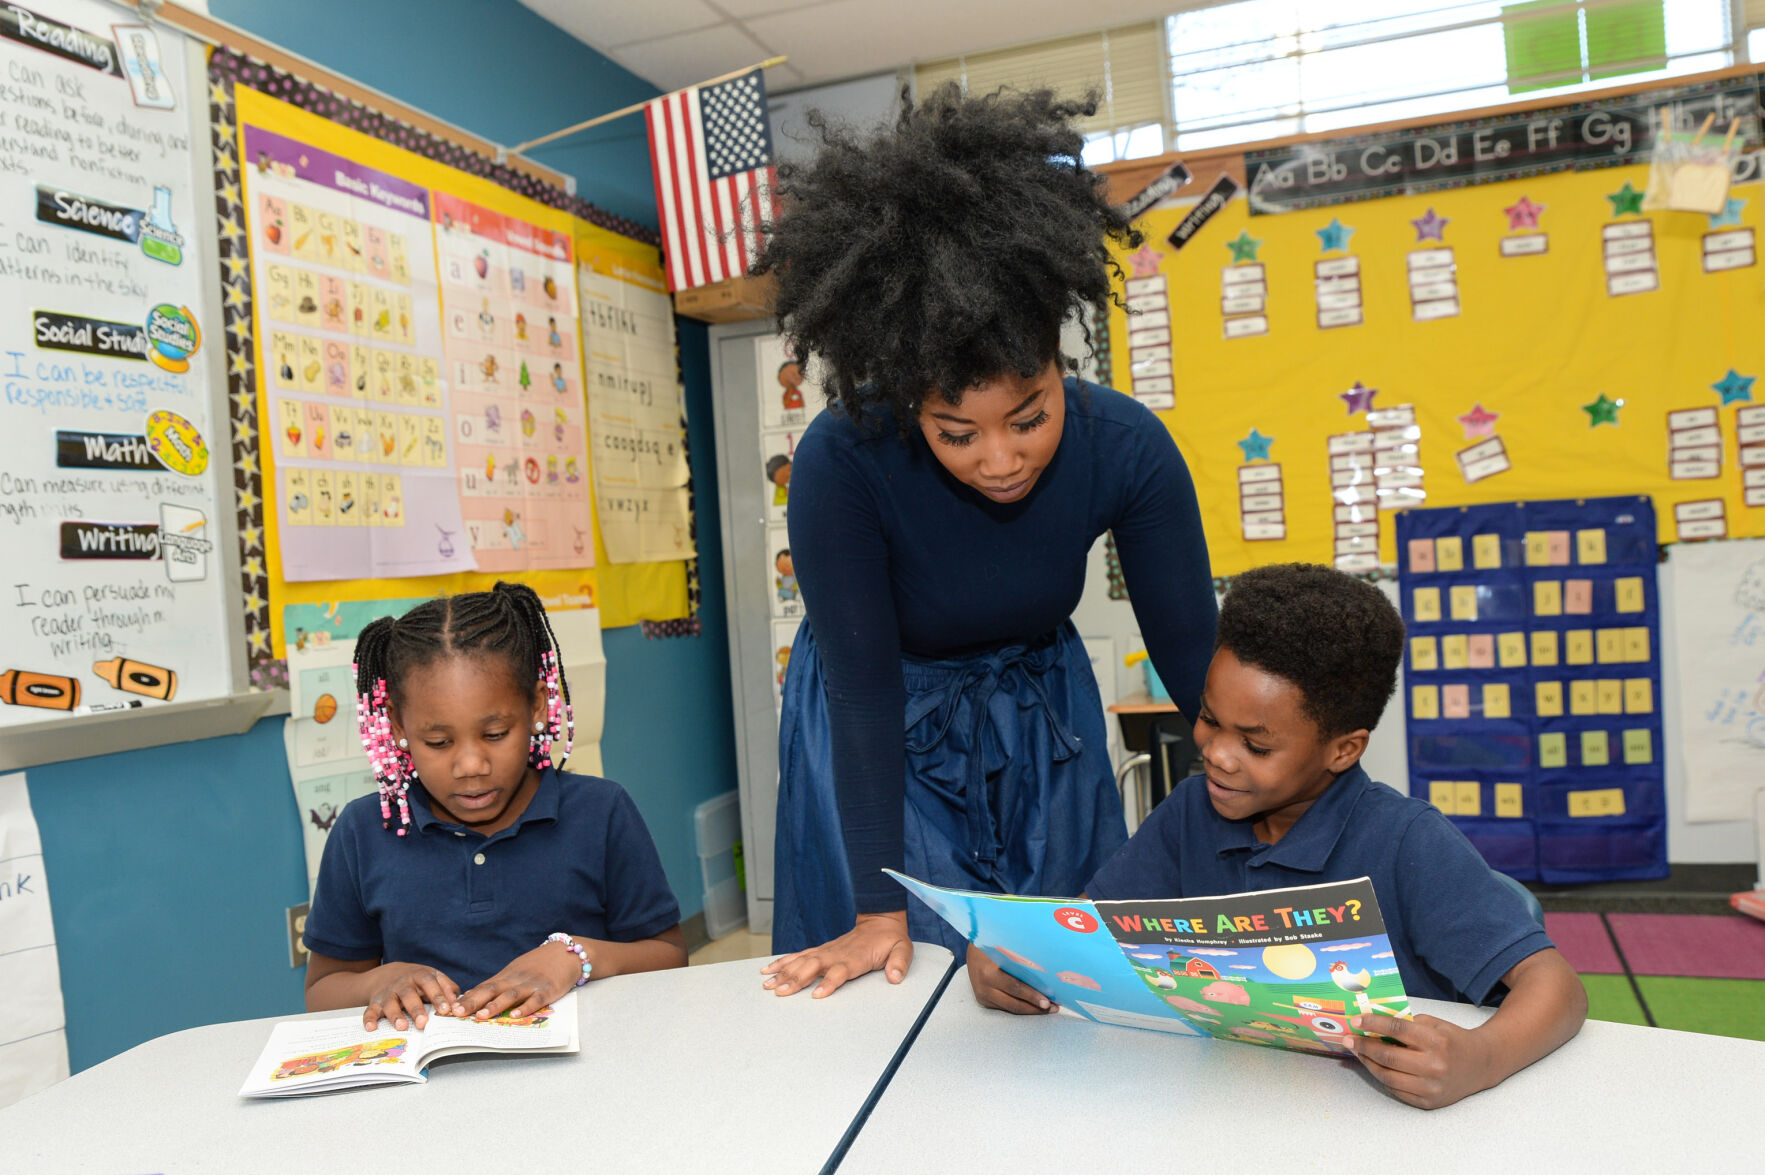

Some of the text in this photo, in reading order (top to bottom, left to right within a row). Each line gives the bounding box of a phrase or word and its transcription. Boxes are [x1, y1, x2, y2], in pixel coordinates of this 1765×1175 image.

[8, 6, 114, 73] Reading
[1251, 162, 1295, 196] Aa
[1307, 152, 1347, 184] Bb
[1360, 145, 1402, 176] Cc
[1414, 136, 1459, 169] Dd
[1473, 129, 1512, 161] Ee
[1527, 118, 1563, 152] Ff
[1581, 111, 1631, 154] Gg
[54, 190, 135, 234] Science
[35, 317, 93, 348] Social
[149, 324, 195, 351] Studies
[152, 309, 190, 337] Social
[4, 351, 30, 379] I
[36, 361, 77, 382] can
[84, 436, 148, 465] Math
[78, 526, 160, 560] Writing
[14, 583, 37, 607] I
[41, 588, 77, 608] can
[32, 613, 83, 636] reader
[1067, 916, 1086, 930] C
[1112, 899, 1362, 934] WHERE ARE THEY?
